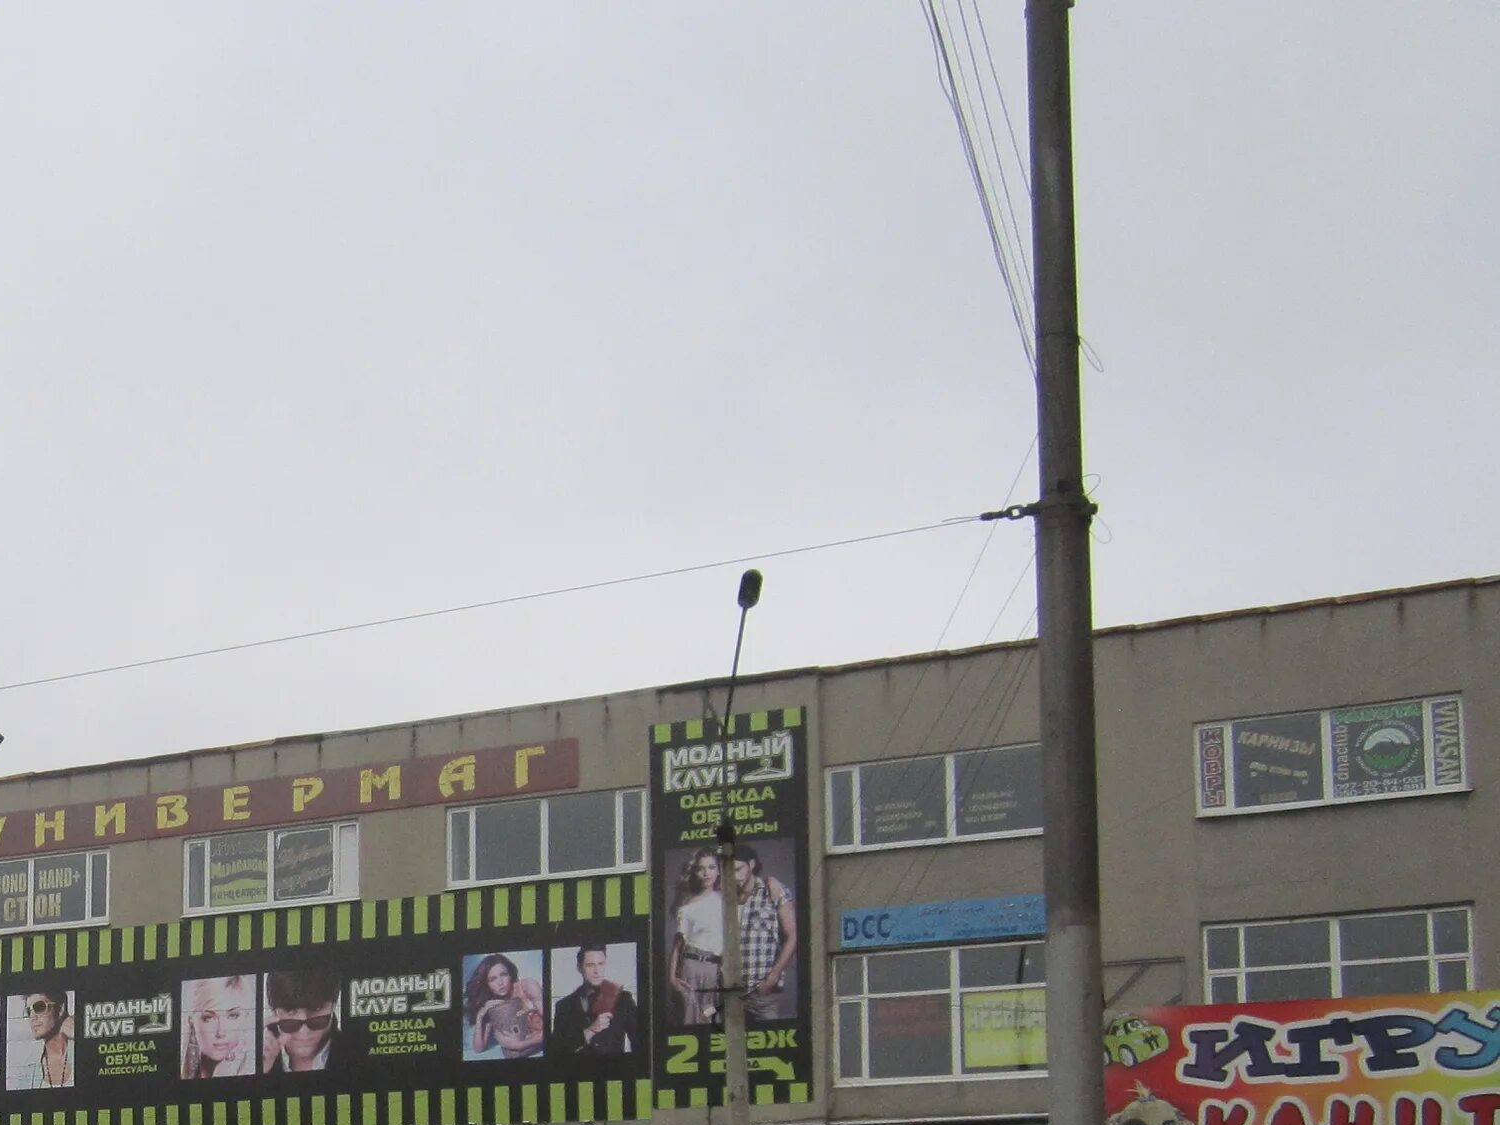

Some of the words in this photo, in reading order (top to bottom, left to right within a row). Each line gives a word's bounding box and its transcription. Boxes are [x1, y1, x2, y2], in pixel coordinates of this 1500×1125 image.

[350, 968, 451, 995] МОДНЫЙ
[84, 993, 172, 1018] МОДНЫЙ
[350, 995, 407, 1017] КЛУБ
[84, 1017, 135, 1038] КЛУБ
[368, 1018, 435, 1032] ОДЕЖДА
[376, 1031, 427, 1044] ОБУВЬ
[98, 1040, 156, 1054] ОДЕЖДА
[368, 1043, 437, 1055] АКСЕССУАРЫ
[105, 1053, 148, 1065] ОБУВЬ
[666, 1035, 699, 1074] 2
[98, 1064, 157, 1075] АКСЕССУАРЫ
